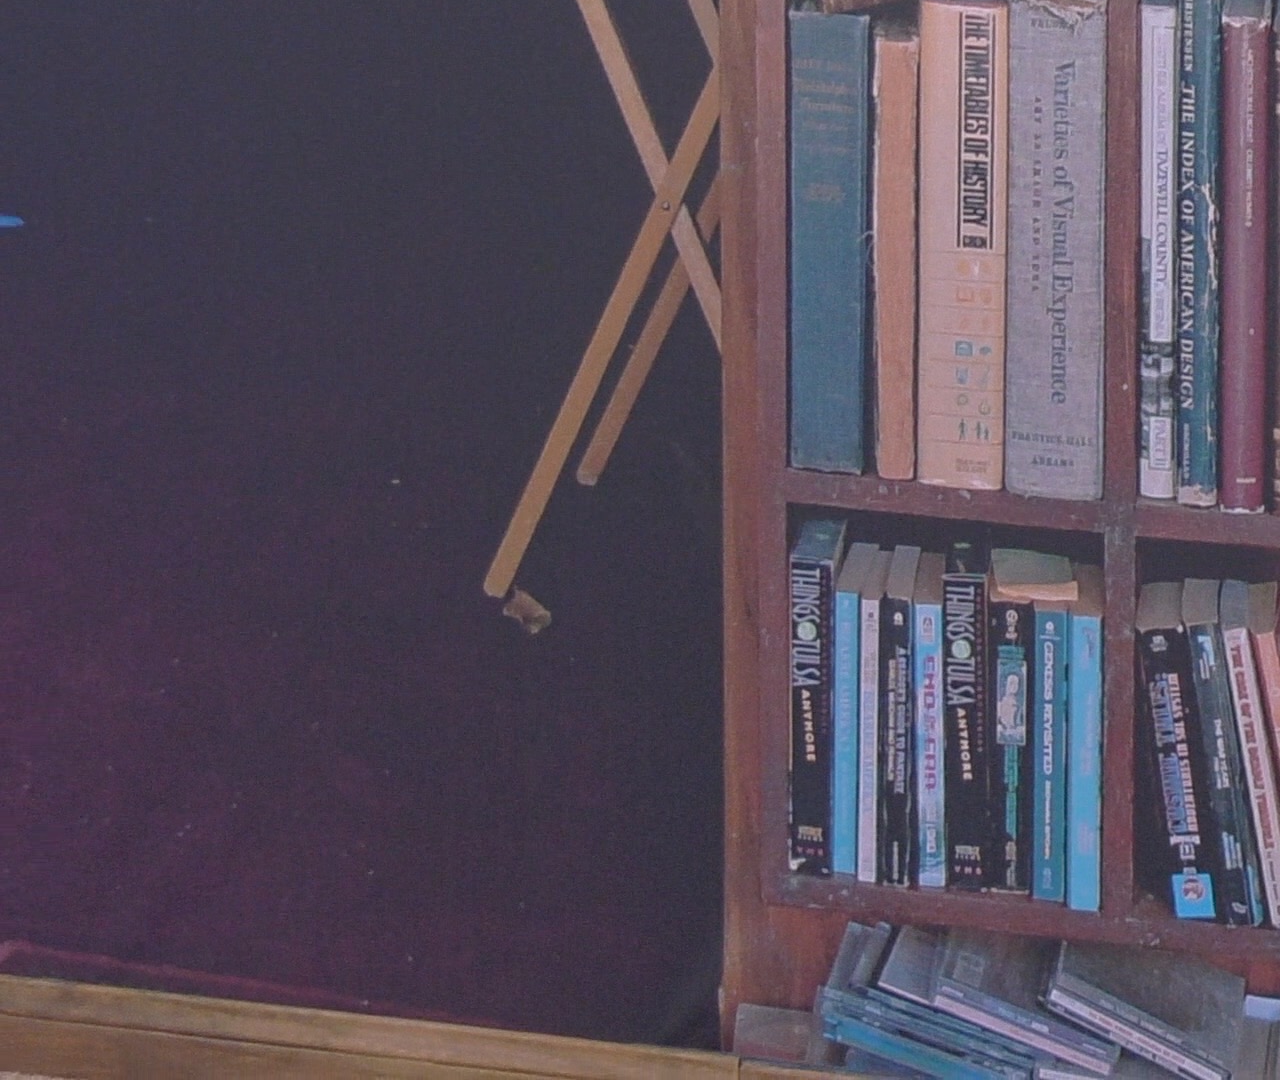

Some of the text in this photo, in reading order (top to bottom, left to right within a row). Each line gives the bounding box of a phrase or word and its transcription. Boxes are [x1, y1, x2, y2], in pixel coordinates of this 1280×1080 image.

[962, 14, 990, 227] THE TIMETABLES OF HISTORY
[1181, 83, 1195, 123] THE
[1181, 131, 1195, 191] INDEX
[1046, 61, 1075, 405] Varieties of Visual Experience
[1181, 200, 1195, 225] OF
[1180, 229, 1194, 333] AMERICAN
[1180, 339, 1194, 411] DESIGN
[791, 568, 822, 762] THINGS TULSA ANYMORE
[944, 585, 976, 781] THINGS TULSA ANYMORE
[1042, 641, 1054, 775] GENESIS REVISITED
